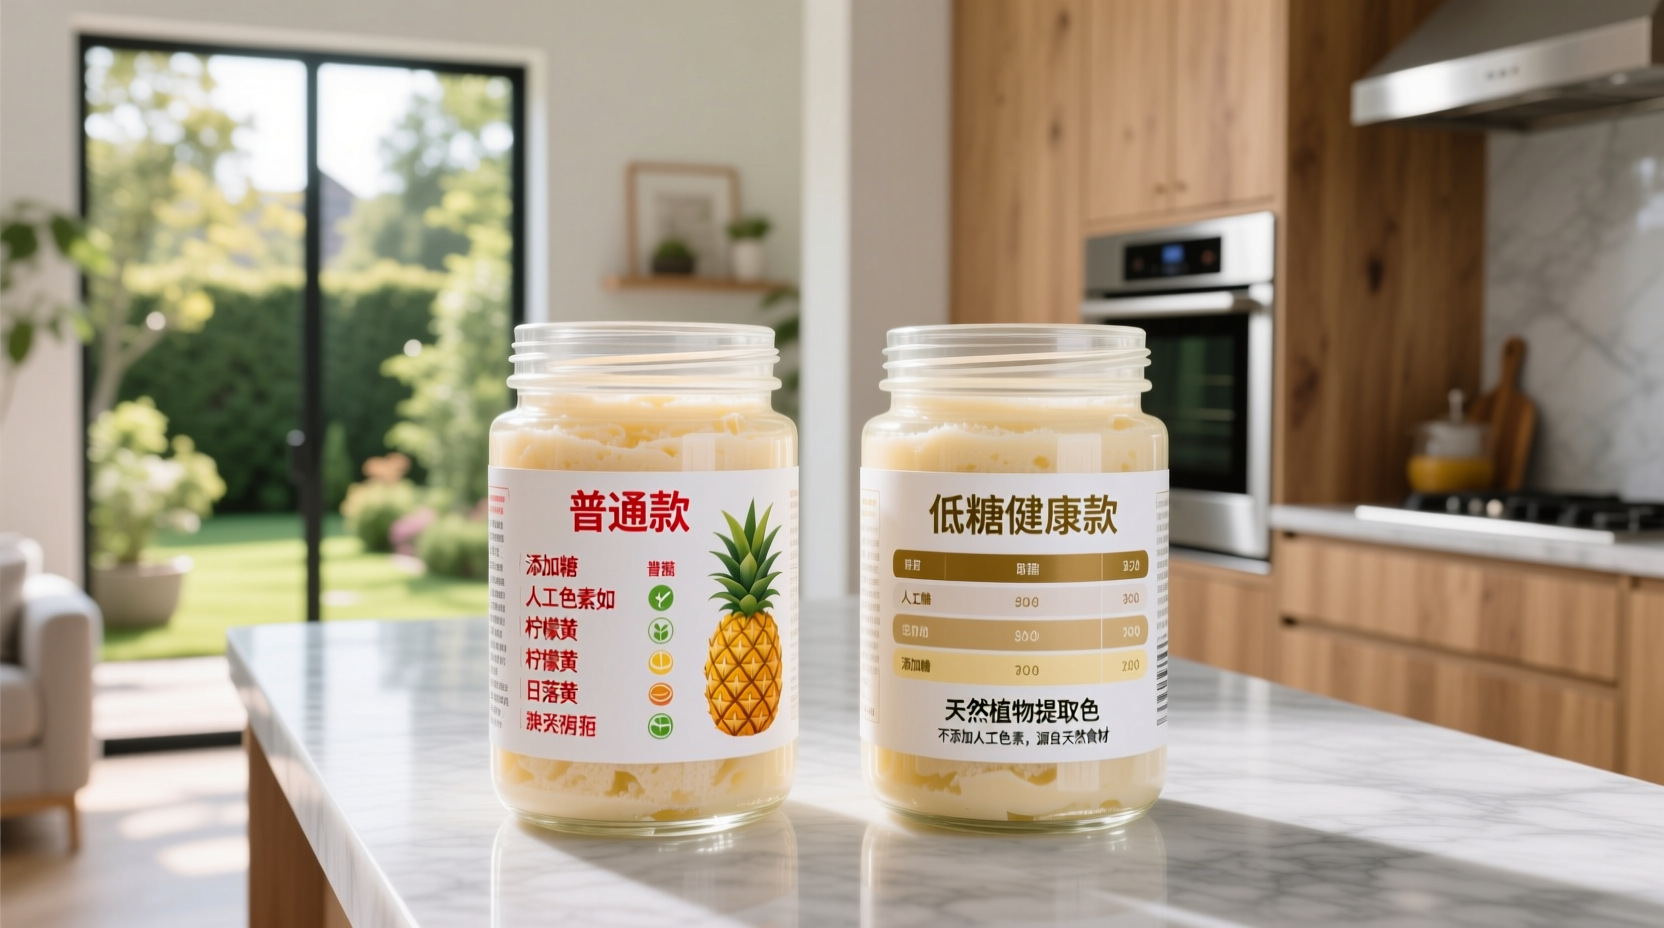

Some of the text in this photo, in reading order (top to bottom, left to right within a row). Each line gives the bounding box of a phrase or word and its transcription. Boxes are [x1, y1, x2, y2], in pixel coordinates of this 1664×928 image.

[569, 489, 690, 533] 普通款
[929, 494, 1118, 536] 低糖健康款
[526, 554, 579, 578] 添加糖
[525, 585, 616, 610] 人工色素如
[945, 697, 1100, 724] 天然植物提取色
